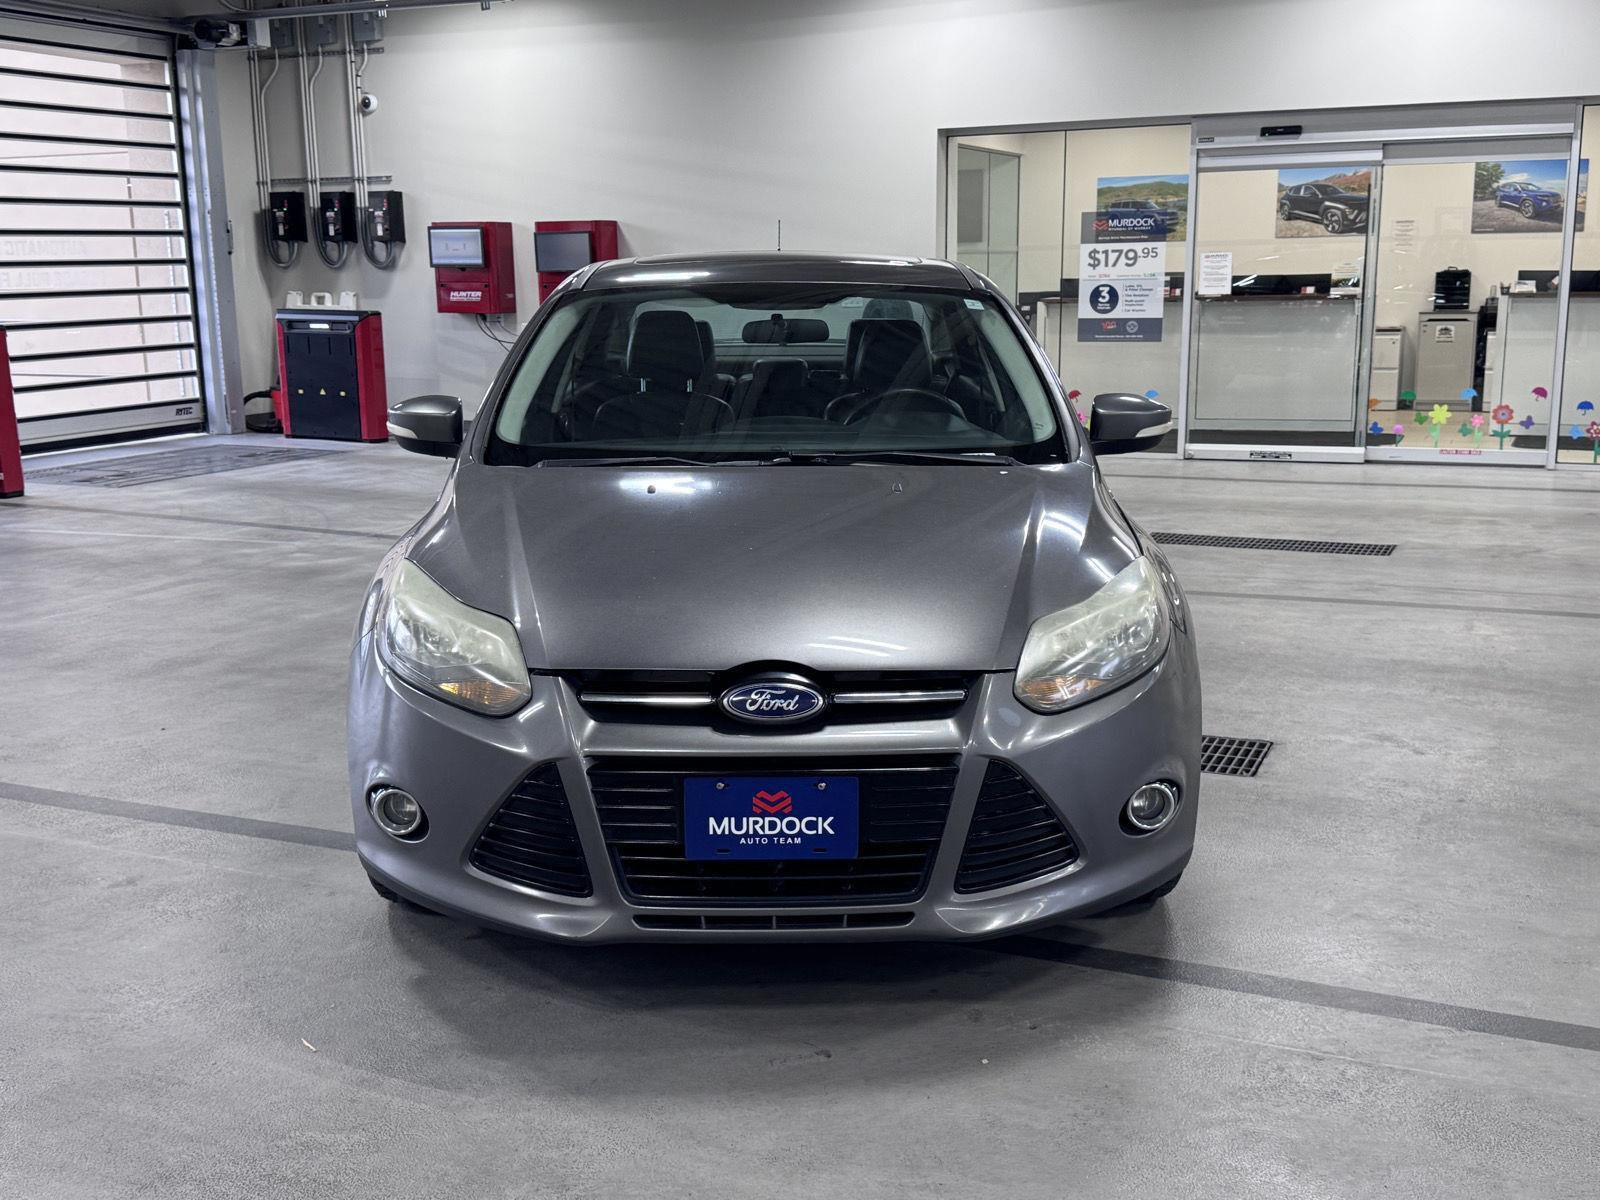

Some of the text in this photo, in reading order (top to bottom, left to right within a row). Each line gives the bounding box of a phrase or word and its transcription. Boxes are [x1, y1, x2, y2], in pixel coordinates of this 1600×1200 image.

[1108, 218, 1155, 227] MURDOCK
[450, 290, 482, 298] HUNTER
[1098, 286, 1110, 303] 3
[745, 688, 800, 711] Ford
[708, 816, 835, 835] MURDOCK
[739, 837, 802, 845] AUTO TEAM
